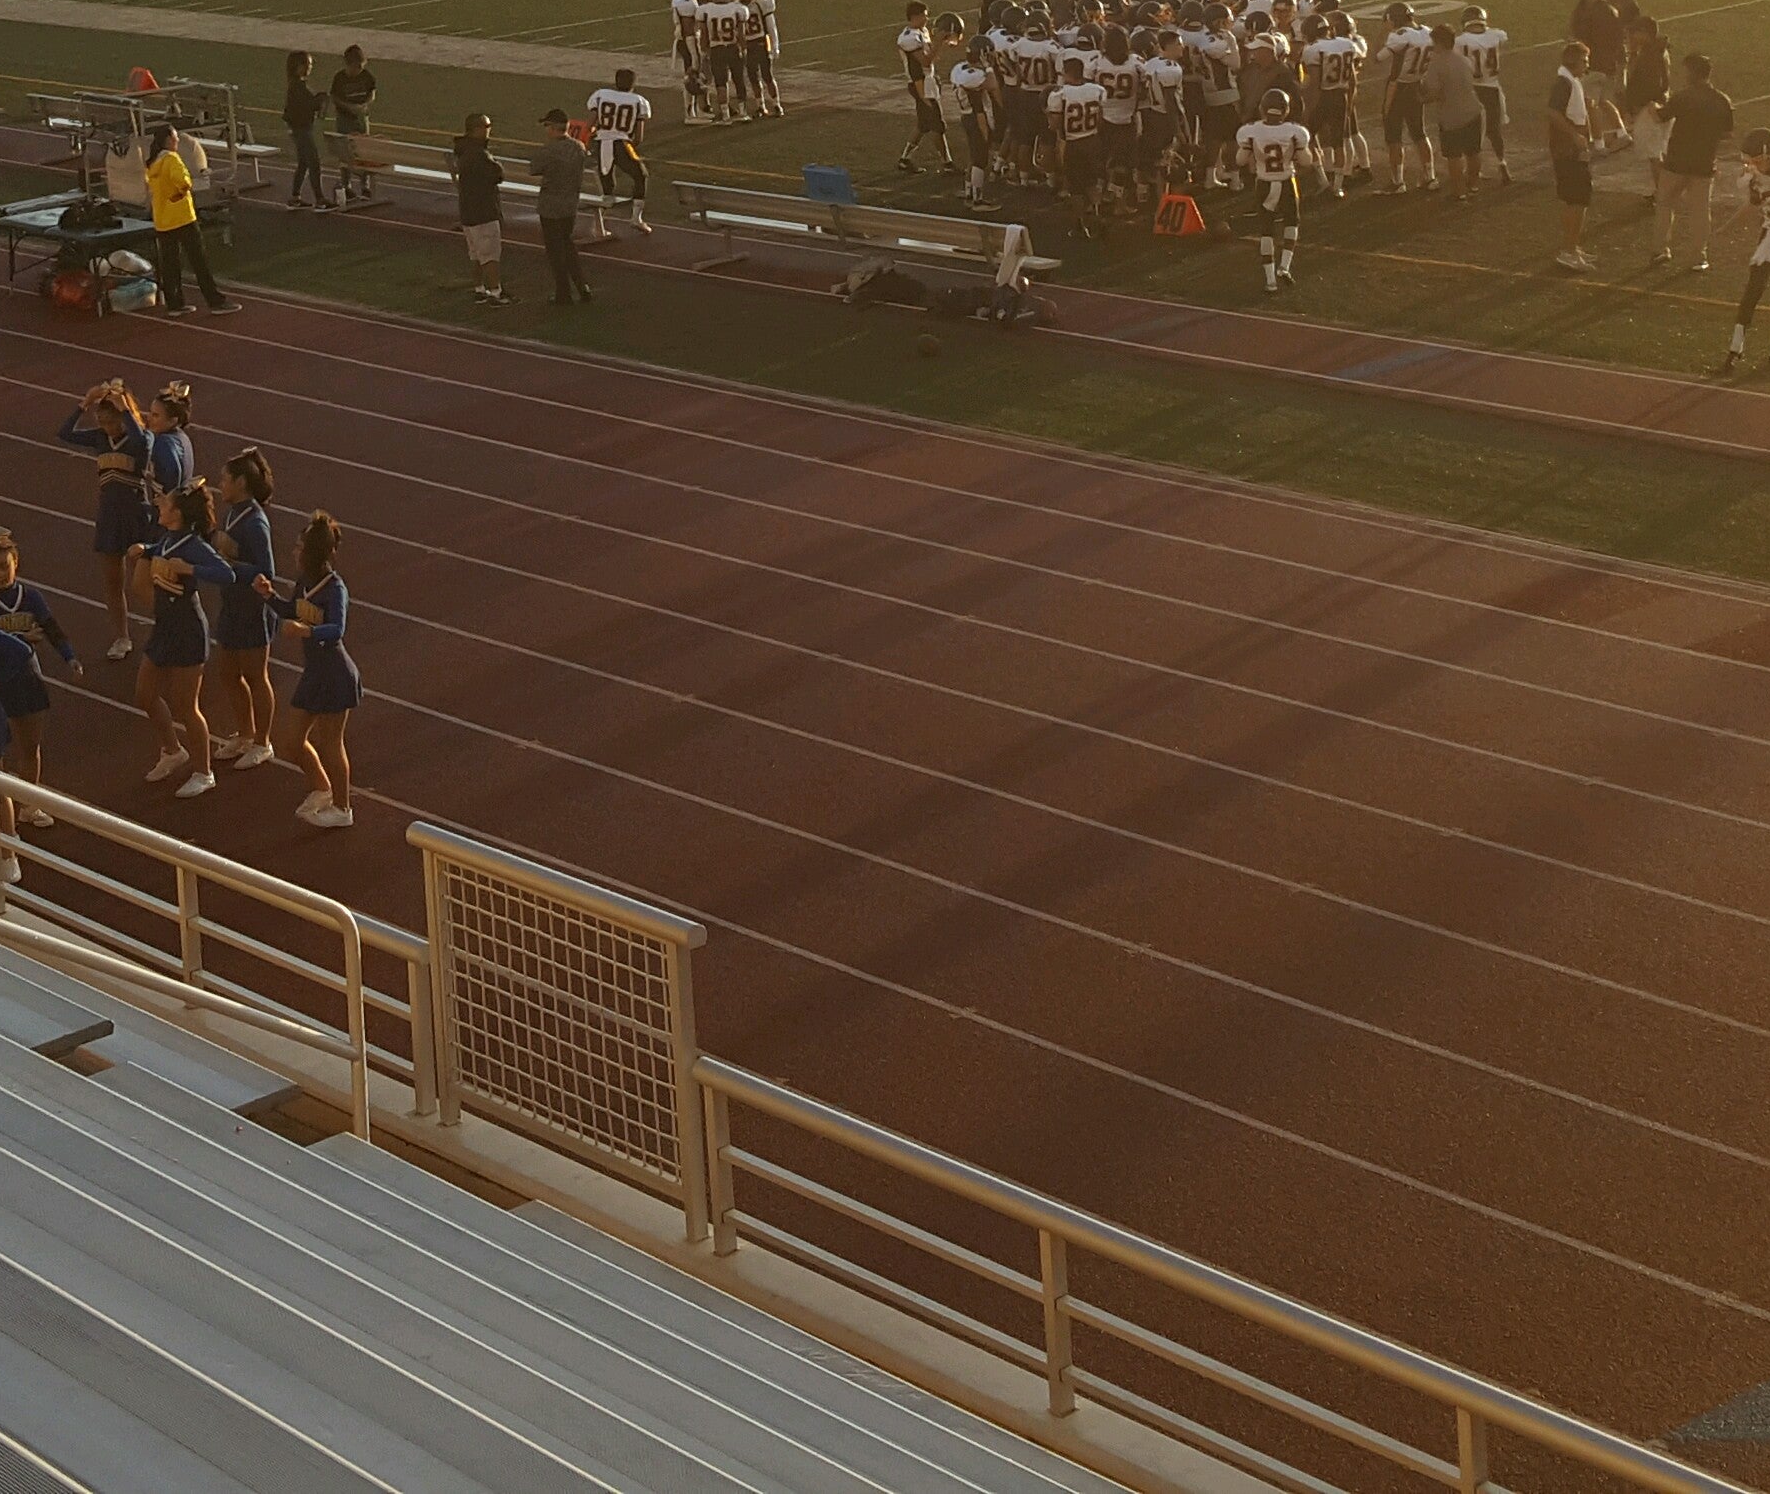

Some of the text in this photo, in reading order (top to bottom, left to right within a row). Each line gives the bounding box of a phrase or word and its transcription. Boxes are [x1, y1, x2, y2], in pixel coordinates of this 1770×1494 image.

[710, 17, 735, 42] 19
[599, 102, 634, 132] 80
[1263, 143, 1285, 173] 2
[1157, 200, 1187, 233] 40
